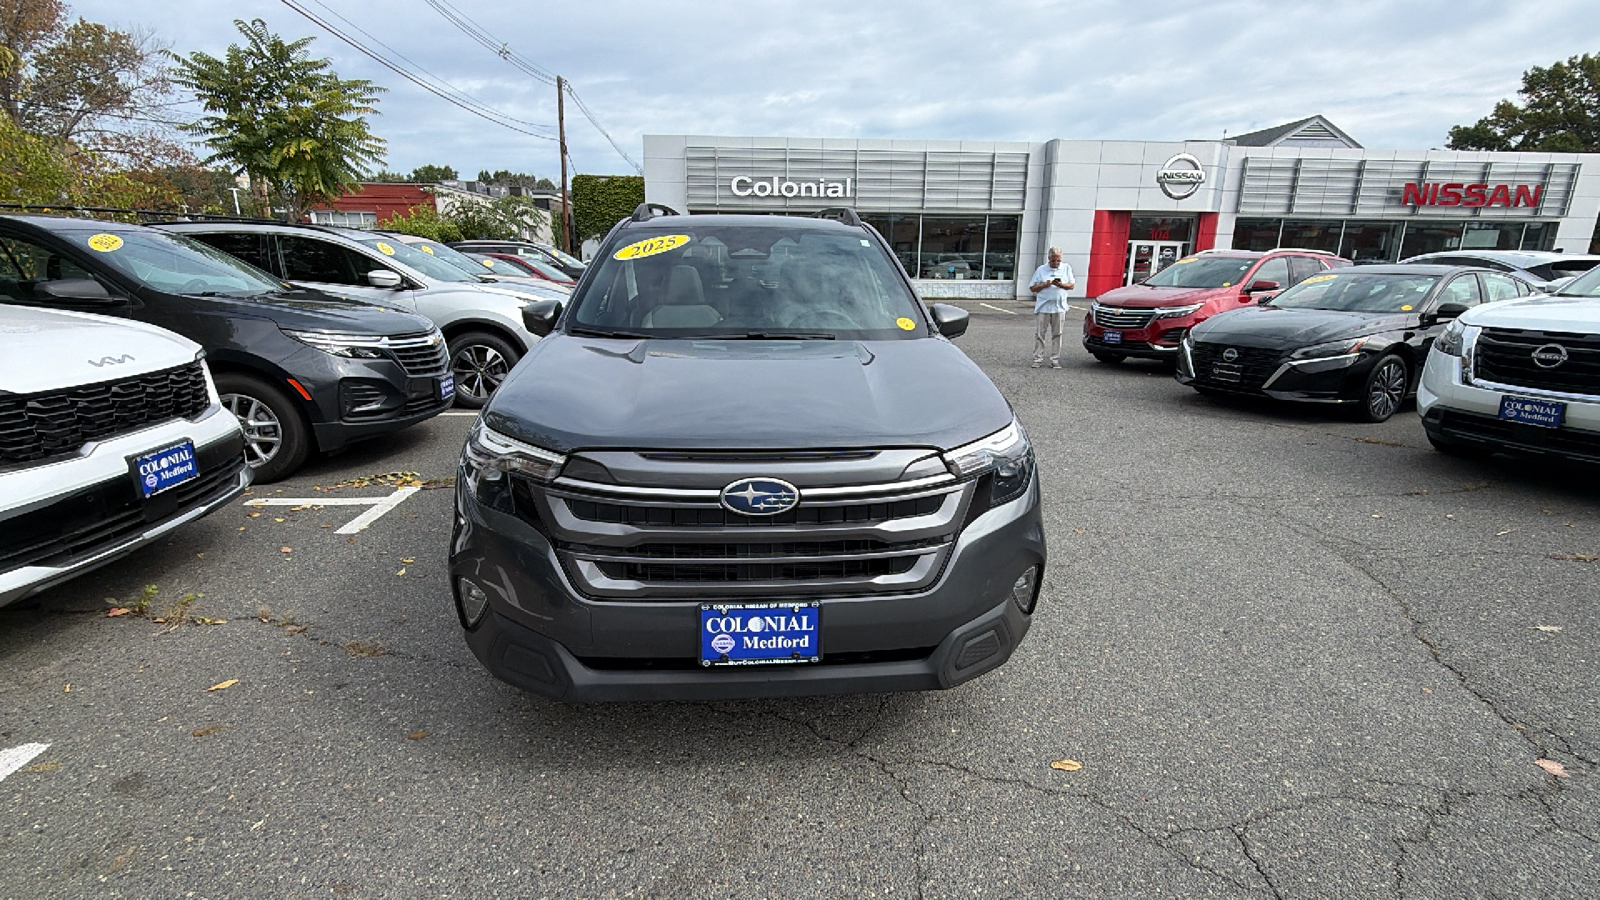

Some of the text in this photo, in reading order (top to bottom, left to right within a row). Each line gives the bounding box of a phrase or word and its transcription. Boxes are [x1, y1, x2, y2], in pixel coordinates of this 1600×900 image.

[1162, 172, 1203, 180] NISSAN
[731, 175, 852, 198] Colonial
[1401, 182, 1543, 208] NISSAN
[1150, 228, 1170, 240] 104
[630, 236, 677, 258] 2025
[1531, 352, 1569, 361] NISSAN
[1504, 401, 1559, 416] COLONIAL
[1520, 411, 1555, 423] Medford
[140, 449, 193, 476] COLONIAL
[161, 461, 193, 481] Medford
[706, 616, 814, 634] COLONIAL
[742, 635, 809, 649] Medford
